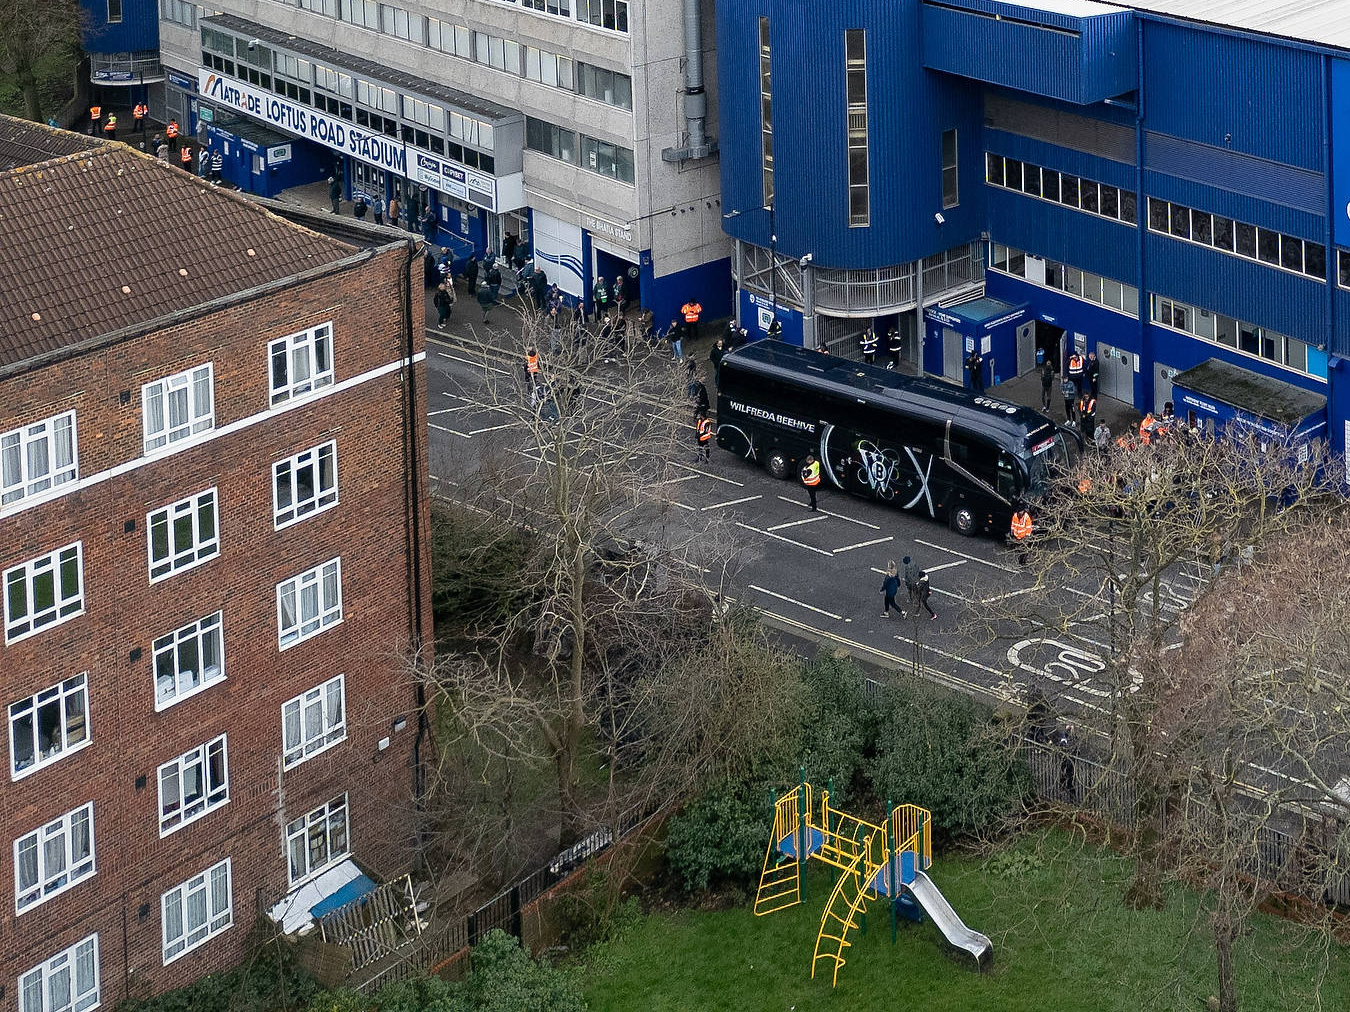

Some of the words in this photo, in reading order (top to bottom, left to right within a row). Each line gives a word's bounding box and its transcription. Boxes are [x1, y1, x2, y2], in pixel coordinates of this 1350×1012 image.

[203, 73, 261, 114] MATRADE
[266, 97, 306, 133] LOFTUS
[310, 114, 345, 148] ROAD
[349, 129, 405, 173] STADIUM
[729, 400, 776, 422] WILFREDA
[776, 414, 815, 433] BEEHIVE
